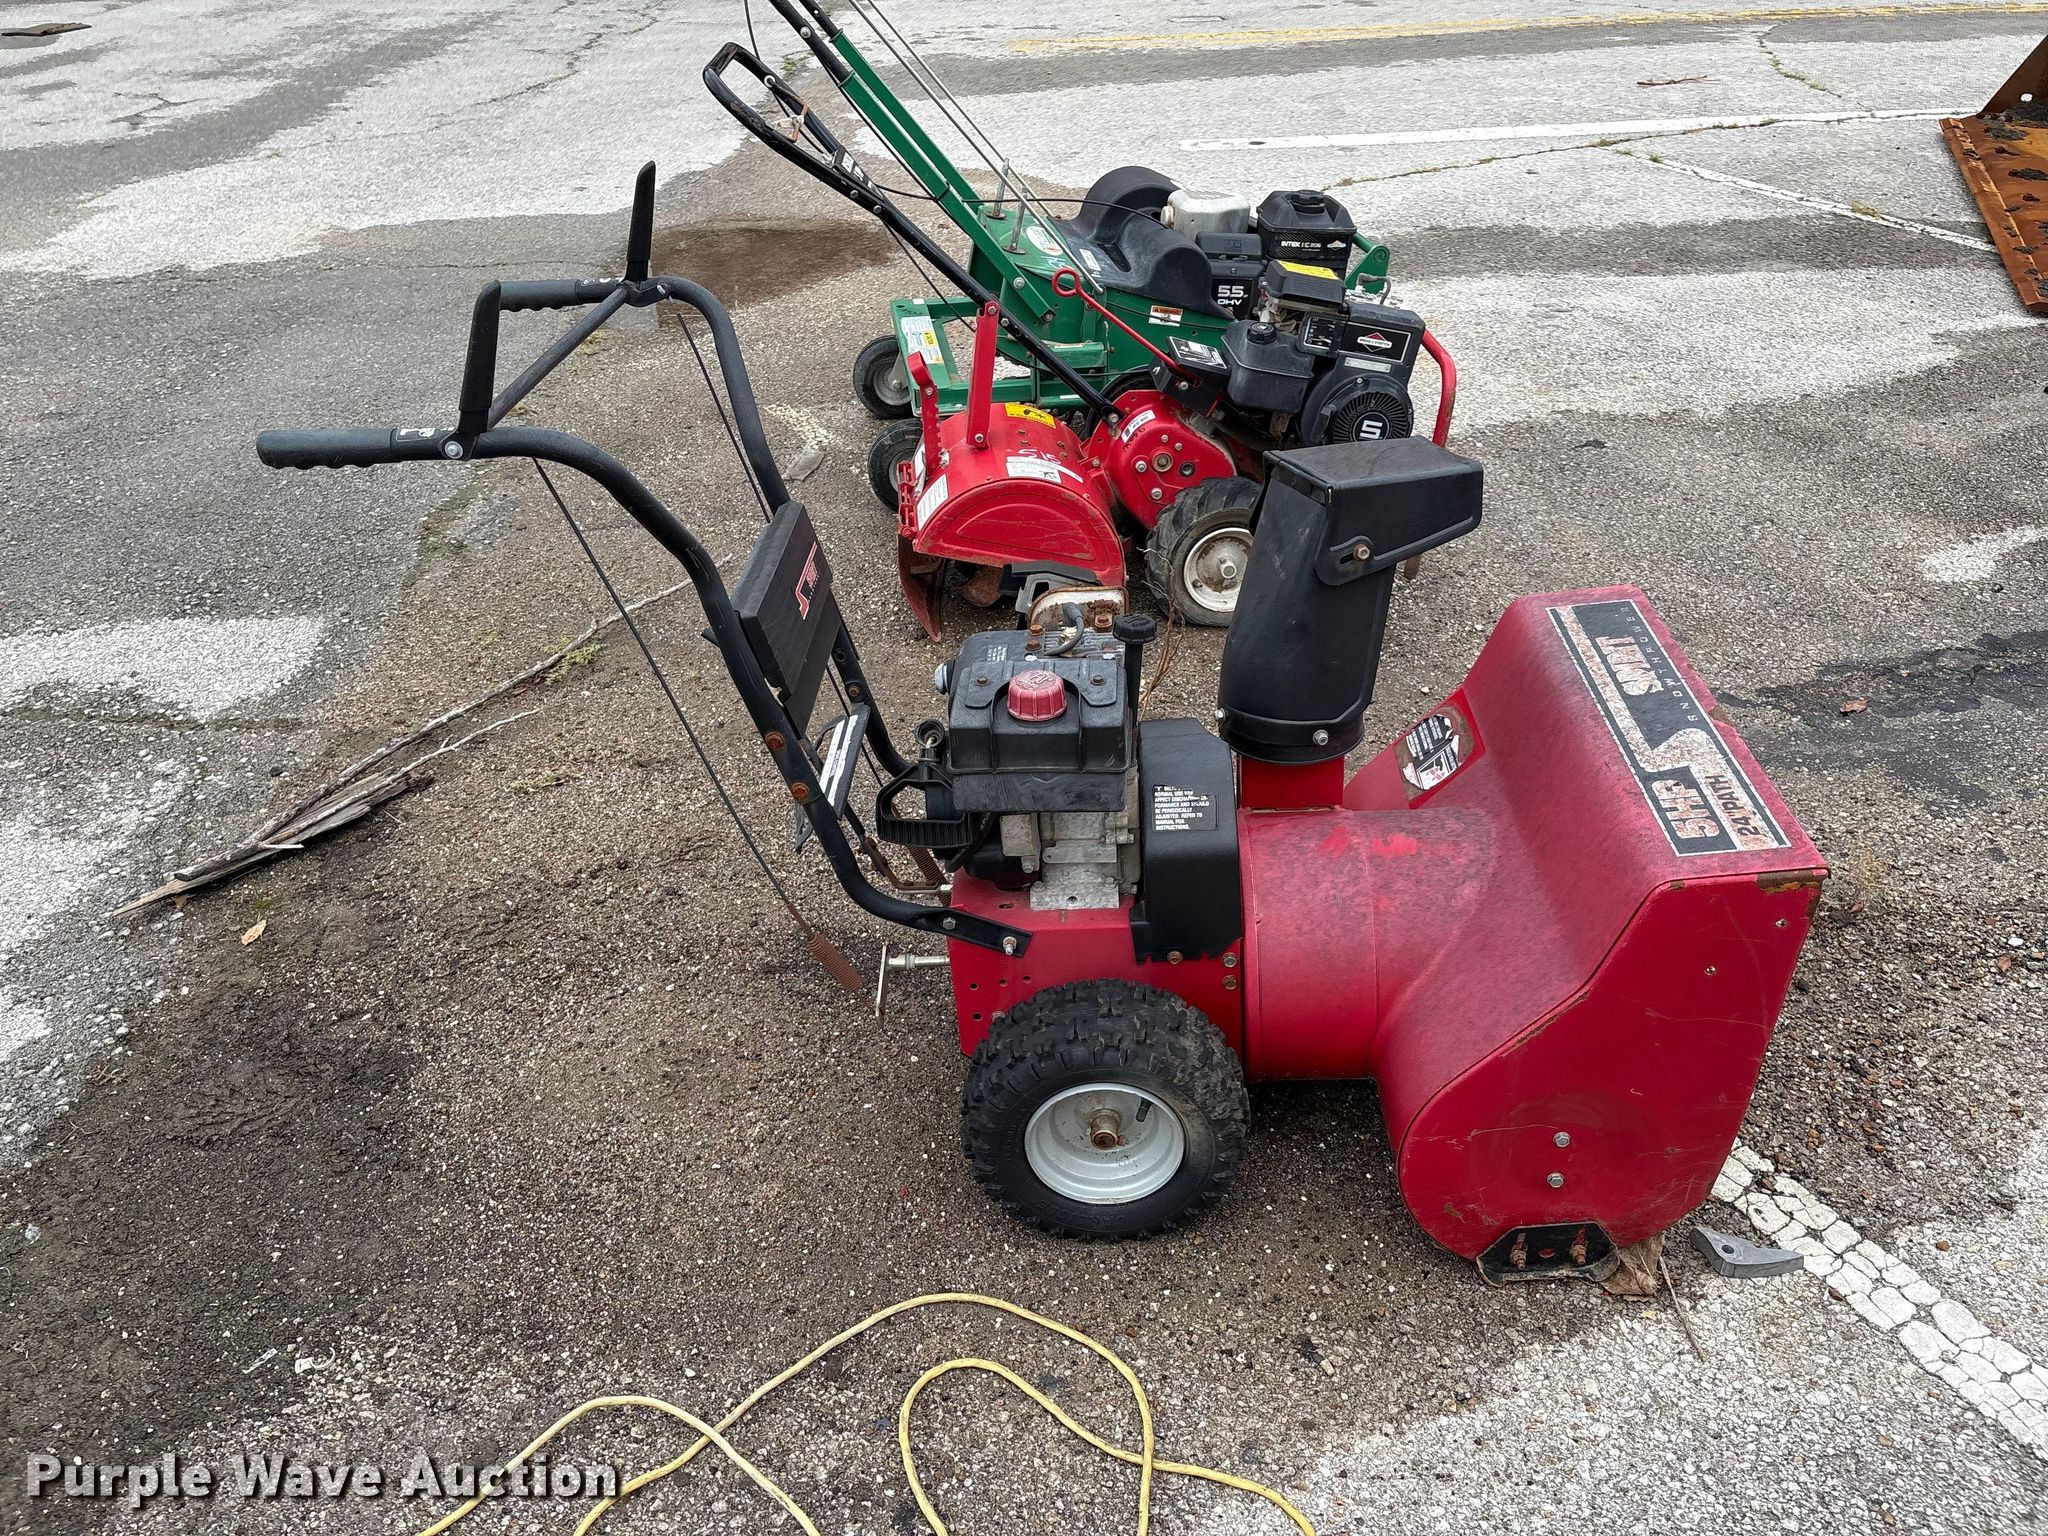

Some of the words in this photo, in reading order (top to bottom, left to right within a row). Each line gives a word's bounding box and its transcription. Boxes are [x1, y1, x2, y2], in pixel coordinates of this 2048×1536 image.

[1281, 240, 1301, 248] INTEK
[1217, 298, 1242, 306] OHV
[1360, 419, 1383, 440] 5
[1651, 779, 1720, 839] 5HP
